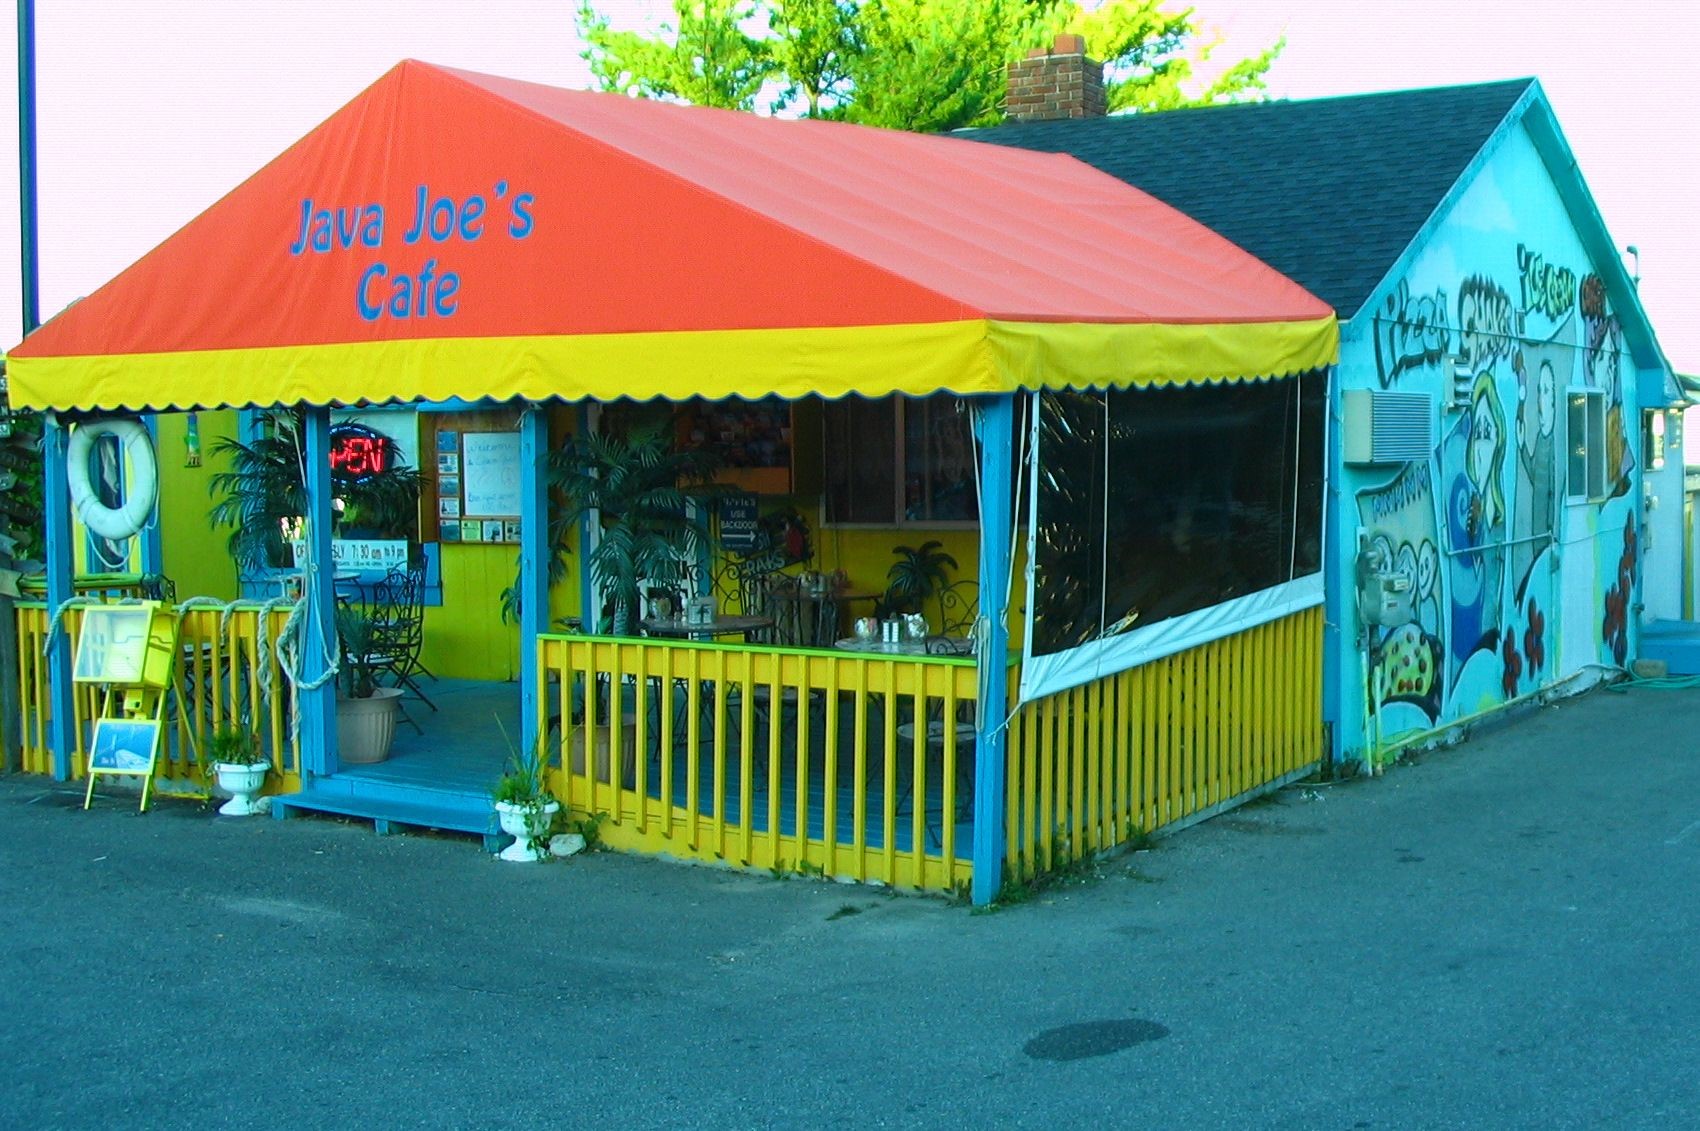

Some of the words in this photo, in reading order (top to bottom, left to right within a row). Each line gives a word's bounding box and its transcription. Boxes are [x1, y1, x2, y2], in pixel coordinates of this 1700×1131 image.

[289, 197, 385, 256] Java
[402, 179, 536, 245] Joe's
[357, 258, 461, 322] Cafe
[730, 510, 746, 519] USE
[352, 544, 370, 559] 7:30
